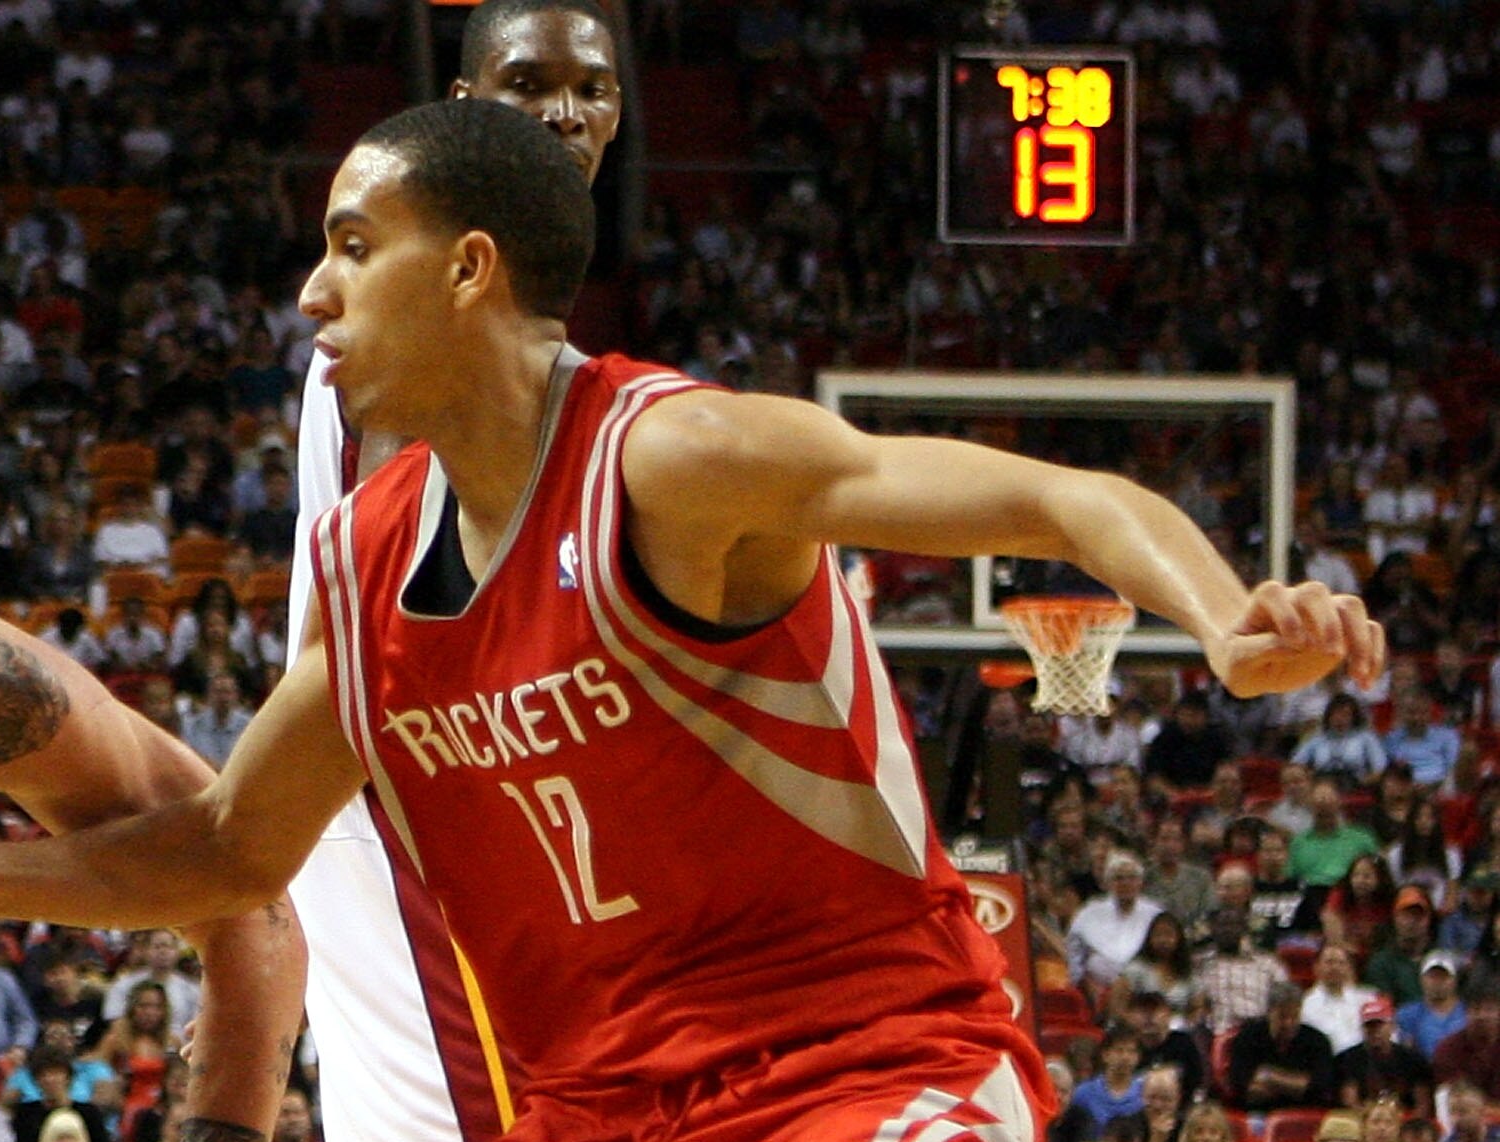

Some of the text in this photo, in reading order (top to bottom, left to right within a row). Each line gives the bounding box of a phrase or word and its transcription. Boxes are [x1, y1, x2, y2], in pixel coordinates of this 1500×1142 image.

[997, 65, 1112, 127] 7:38
[1013, 124, 1096, 222] 13
[499, 775, 640, 924] 12
